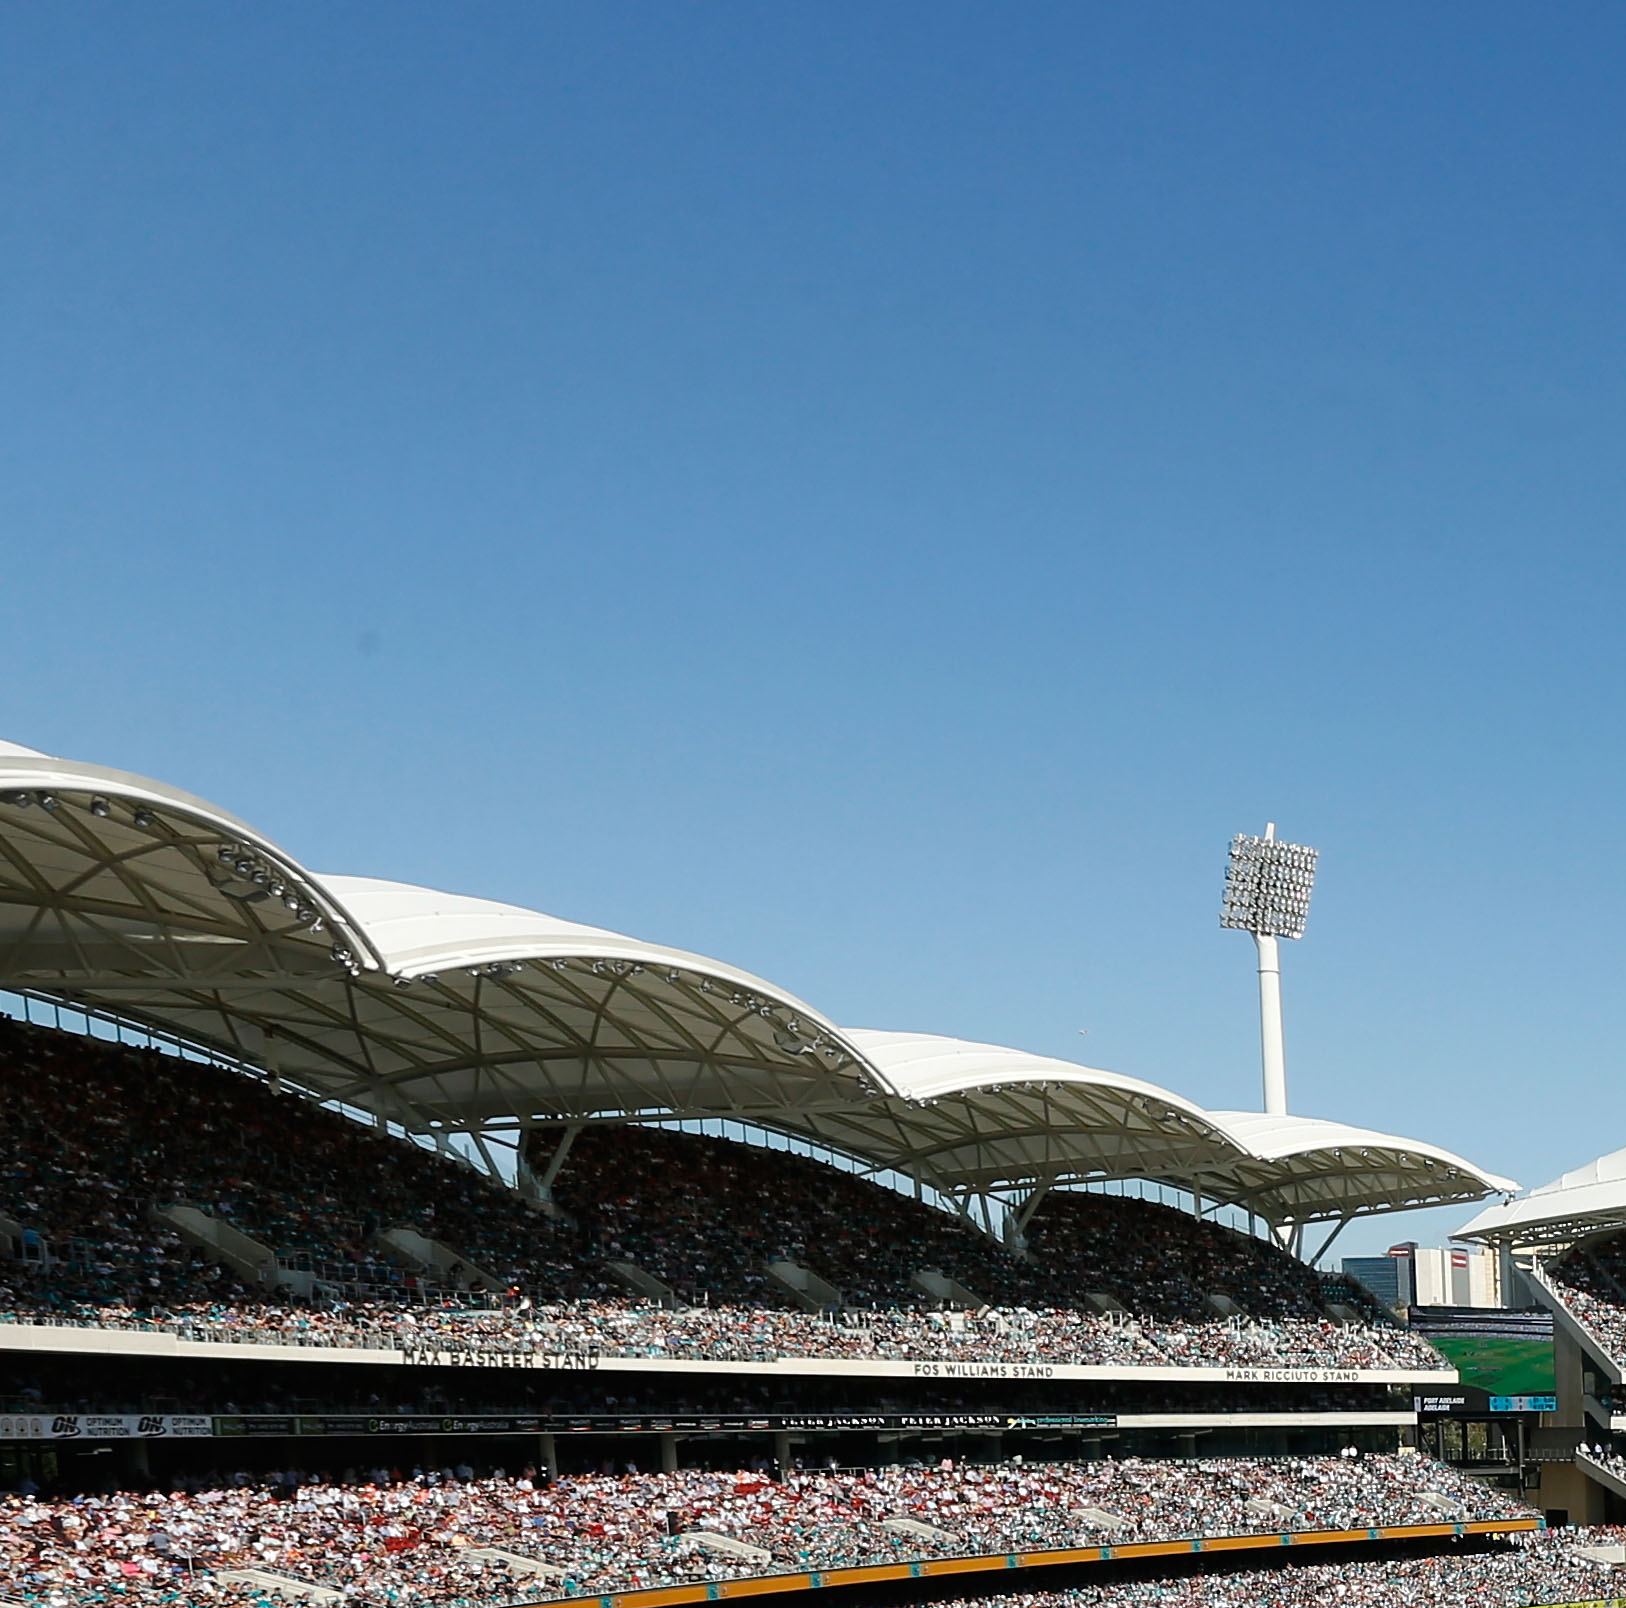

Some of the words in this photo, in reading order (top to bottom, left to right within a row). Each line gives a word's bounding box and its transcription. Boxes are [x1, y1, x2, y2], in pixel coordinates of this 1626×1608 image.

[402, 1348, 441, 1365] MAX
[542, 1352, 599, 1369] STAND
[914, 1364, 939, 1376] FOS
[945, 1365, 1007, 1377] WILLIAMS
[1013, 1366, 1053, 1377] STAND
[1226, 1370, 1258, 1380] MARK
[1263, 1371, 1318, 1381] RICCIUTO
[1323, 1372, 1359, 1381] STAND
[52, 1416, 79, 1434] ON
[86, 1418, 123, 1426] OPTIMUM
[137, 1416, 164, 1434] ON
[171, 1418, 206, 1426] OPTIMUM
[782, 1417, 824, 1426] PETER
[828, 1416, 885, 1426] JACKSON
[902, 1417, 942, 1425] PETER
[944, 1416, 1001, 1426] JACKSON
[87, 1428, 129, 1436] NUTRITION
[172, 1428, 212, 1436] NUTRITION
